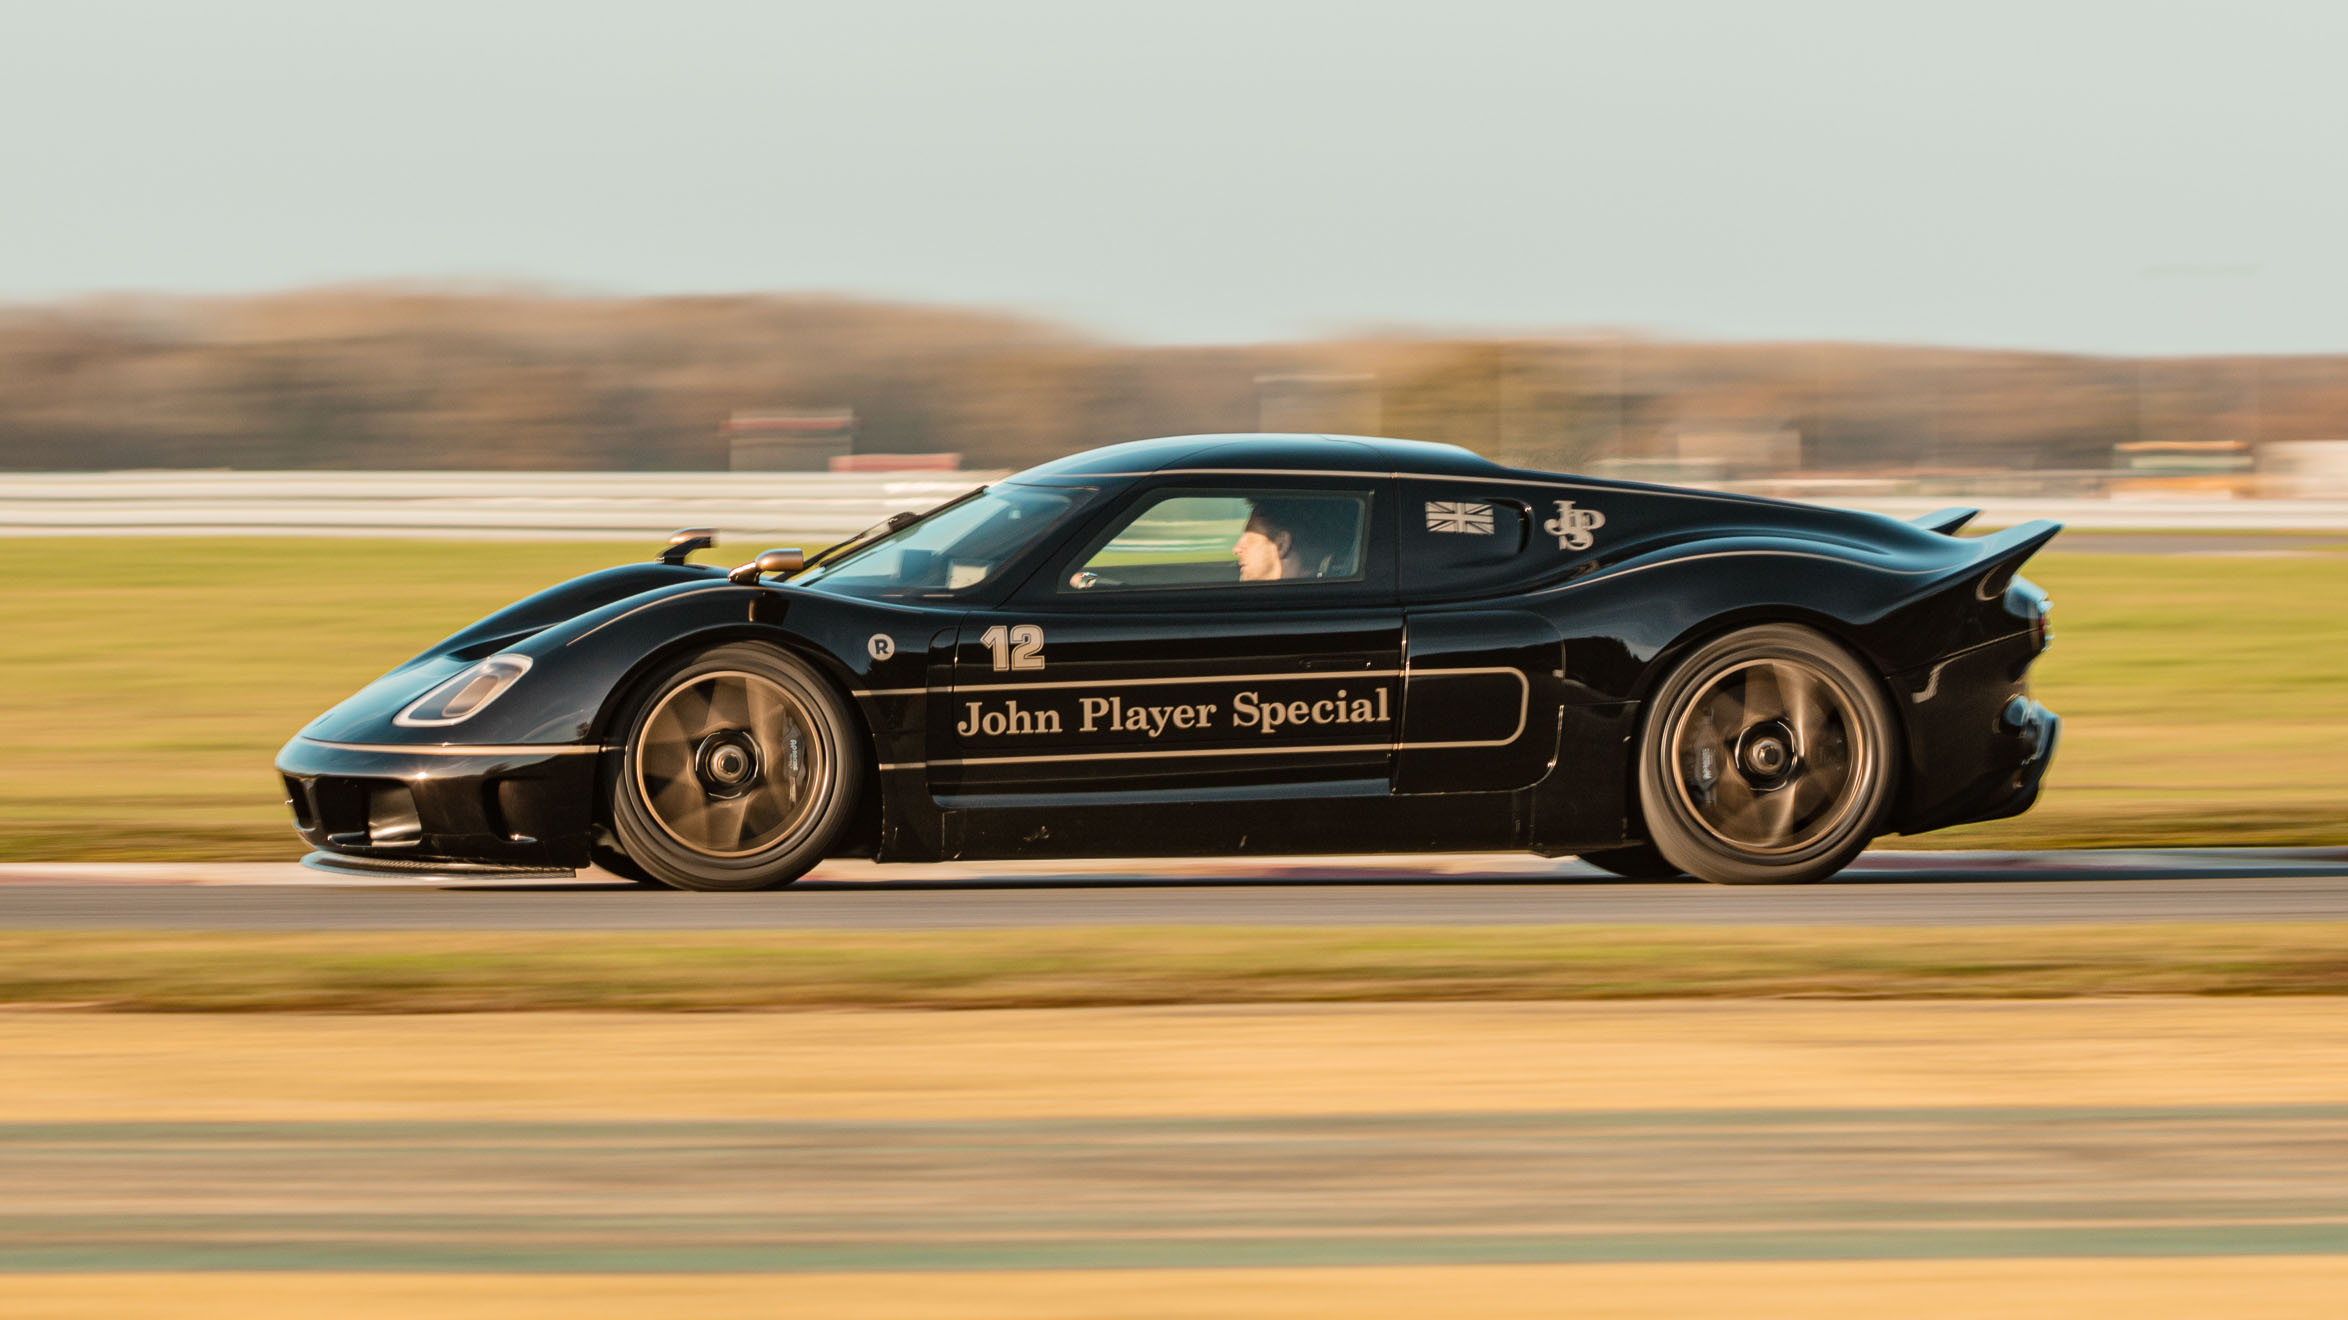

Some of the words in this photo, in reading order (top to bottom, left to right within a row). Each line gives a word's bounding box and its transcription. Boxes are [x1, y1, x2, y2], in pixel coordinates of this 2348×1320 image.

[979, 624, 1046, 672] 12
[957, 700, 1063, 737] John
[1079, 697, 1217, 738] Player
[1233, 687, 1391, 734] Special
